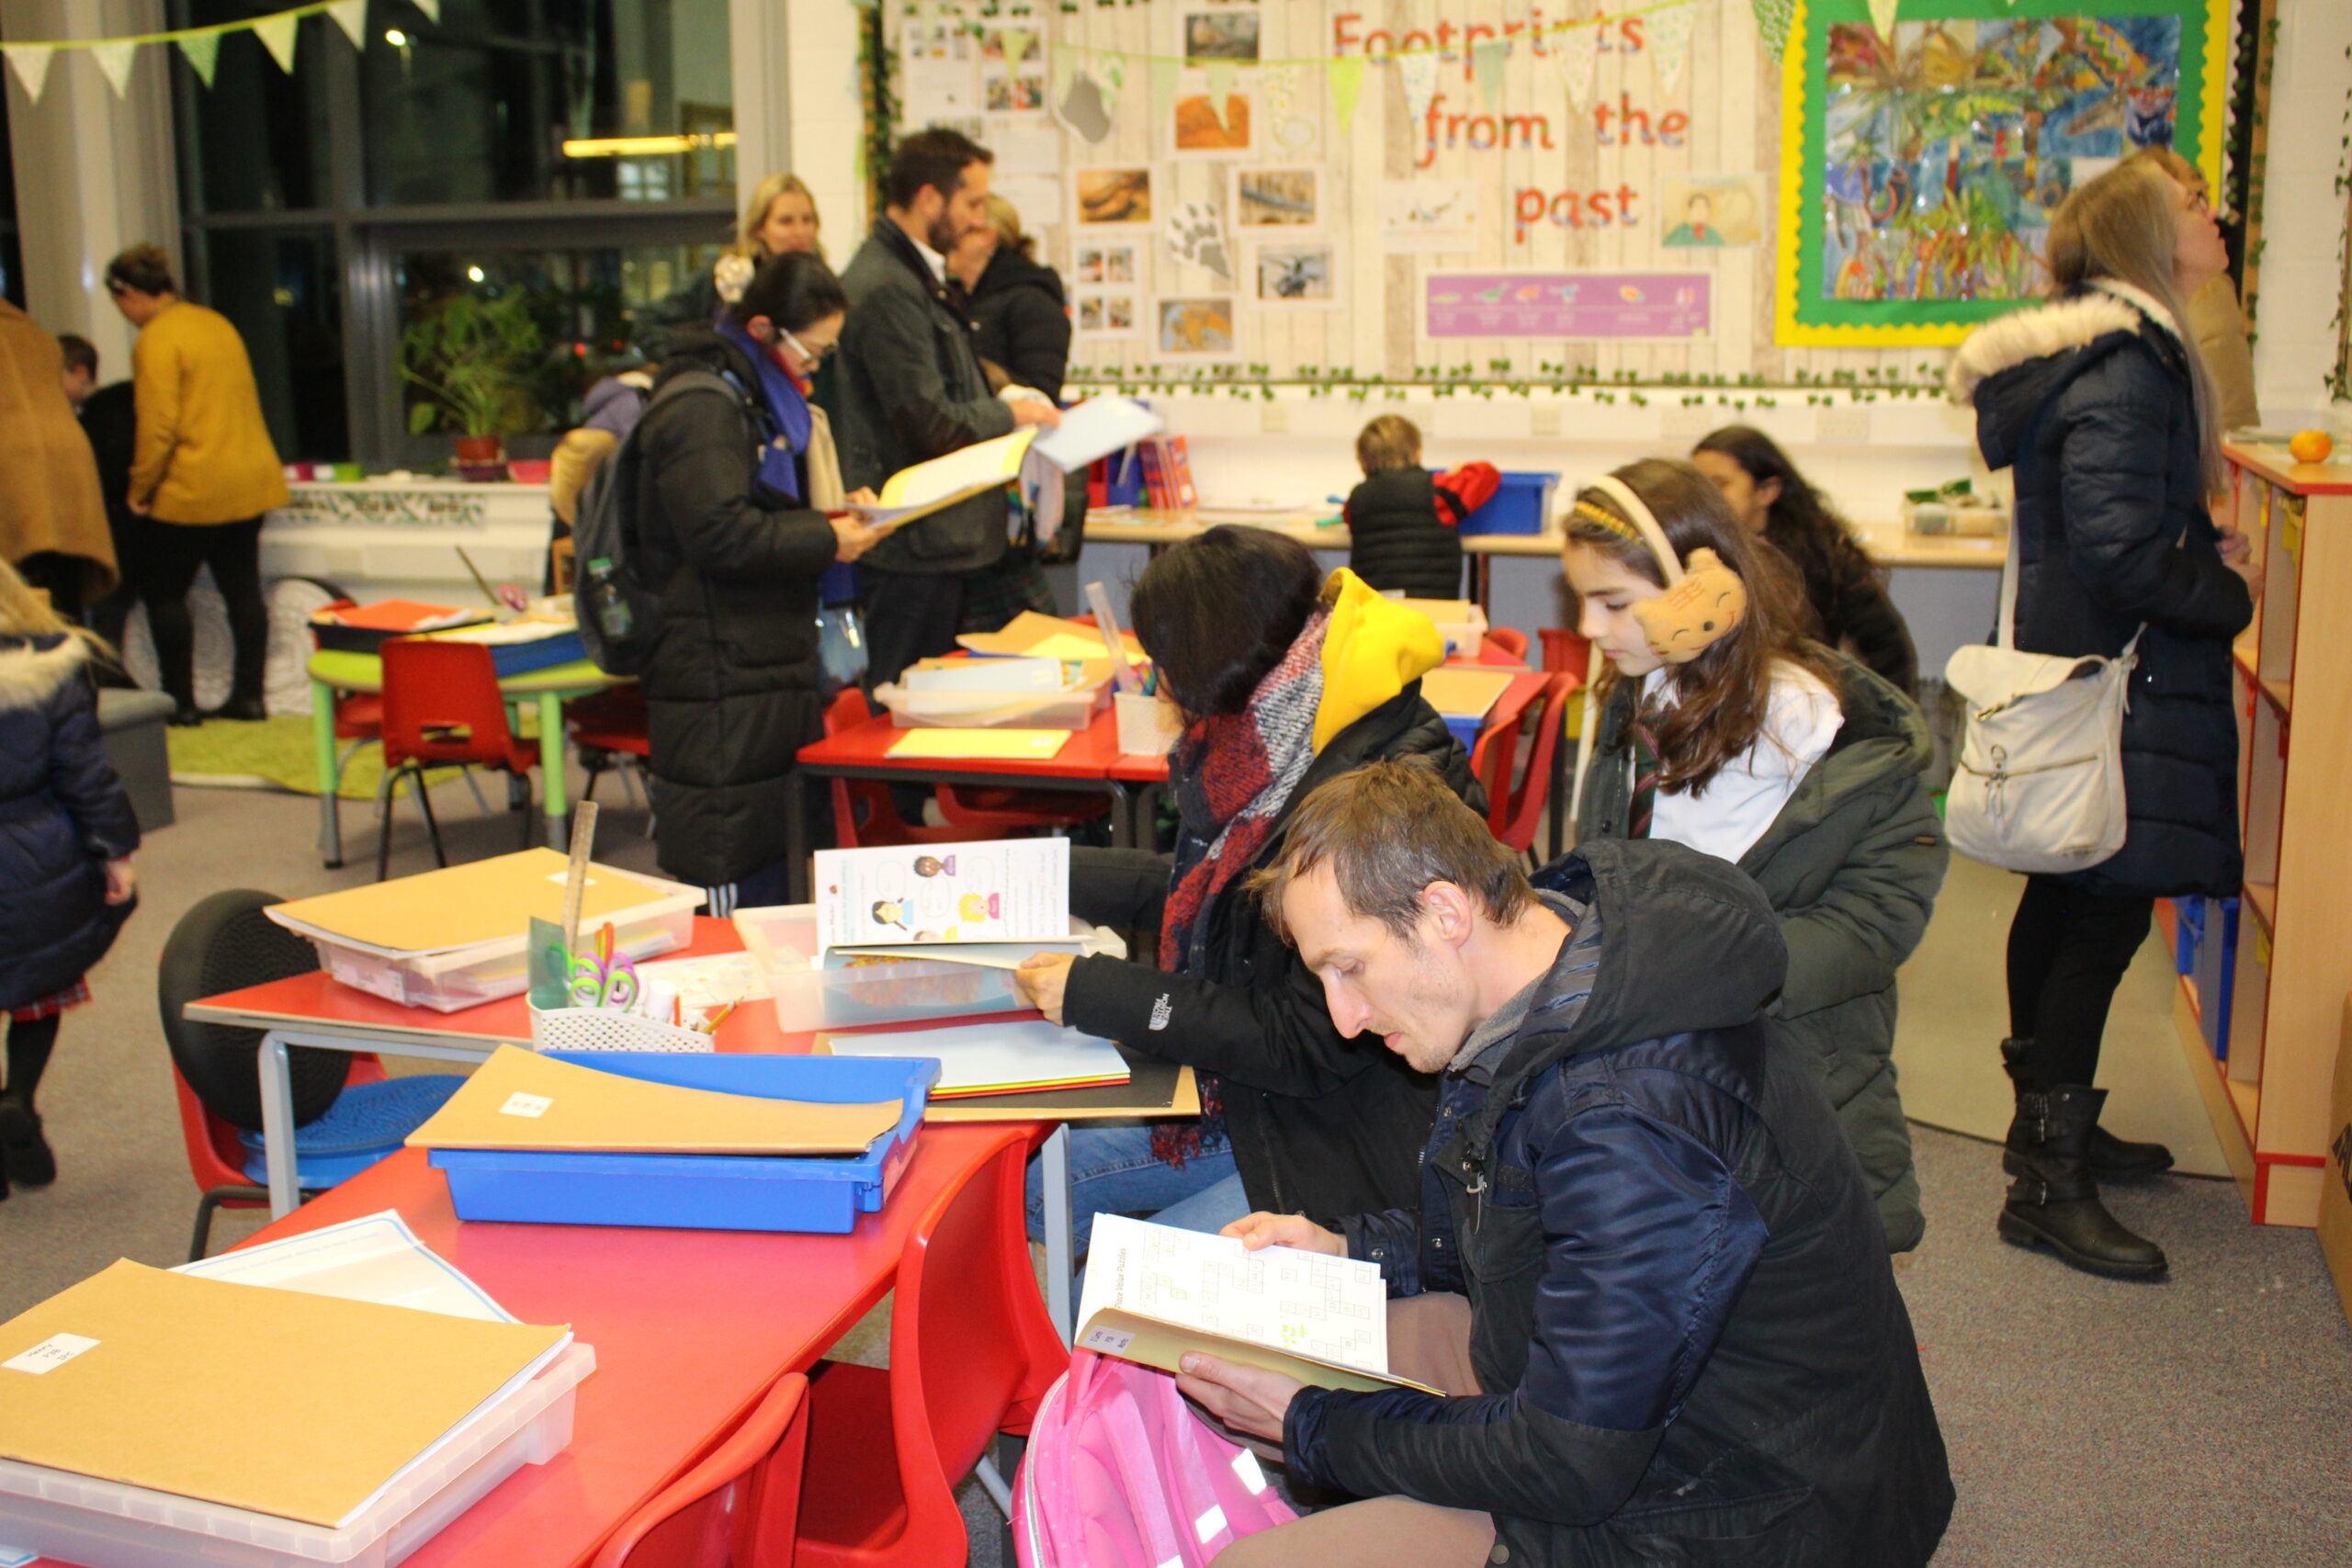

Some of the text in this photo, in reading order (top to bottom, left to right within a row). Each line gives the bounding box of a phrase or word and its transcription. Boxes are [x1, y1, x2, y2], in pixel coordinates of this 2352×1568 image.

[1333, 8, 1644, 82] Footprits
[1414, 91, 1690, 168] from the
[1516, 185, 1639, 245] past
[1114, 1248, 1126, 1309] Place Value Puzzles
